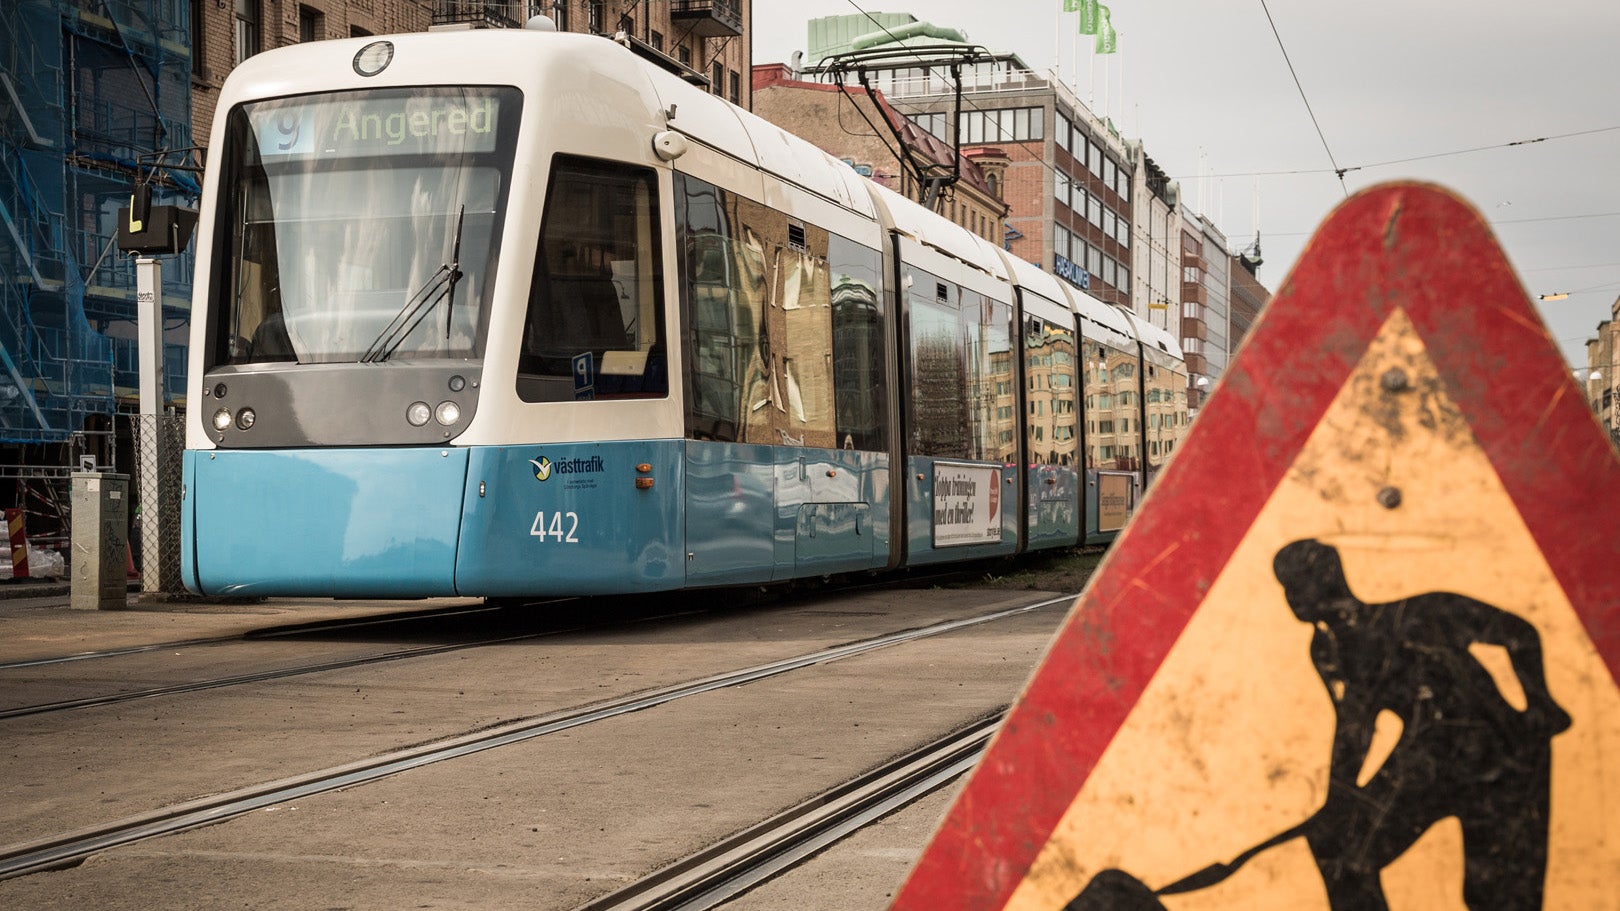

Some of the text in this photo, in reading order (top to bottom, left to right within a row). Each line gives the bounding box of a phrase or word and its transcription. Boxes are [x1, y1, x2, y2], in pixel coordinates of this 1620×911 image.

[277, 98, 492, 150] 9 Angered
[554, 456, 604, 474] västtrafik
[530, 511, 579, 543] 442
[935, 502, 947, 525] med
